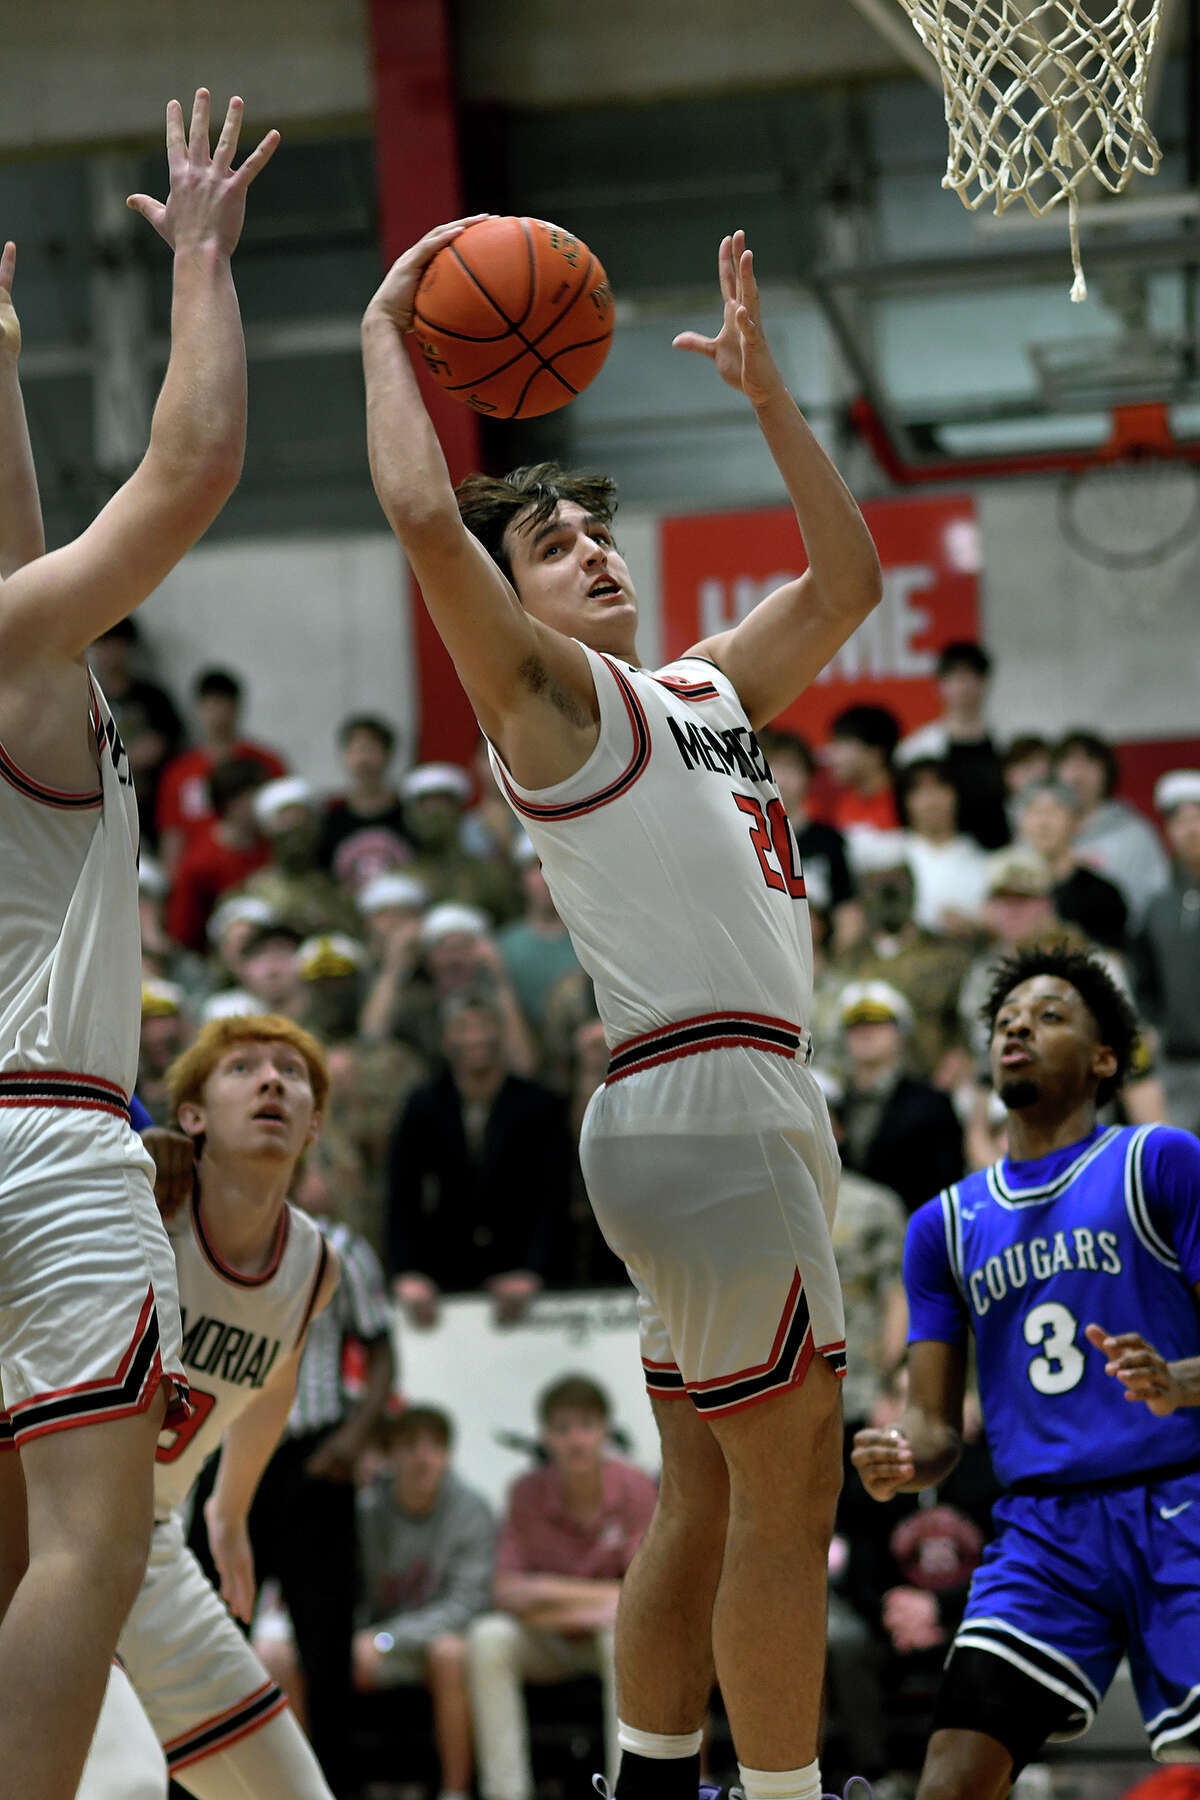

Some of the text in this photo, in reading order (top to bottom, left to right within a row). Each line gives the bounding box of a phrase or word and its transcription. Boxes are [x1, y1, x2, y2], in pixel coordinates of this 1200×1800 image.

[667, 716, 776, 784] MEMOR
[969, 1227, 1122, 1317] COUGARS
[1023, 1302, 1085, 1396] 3
